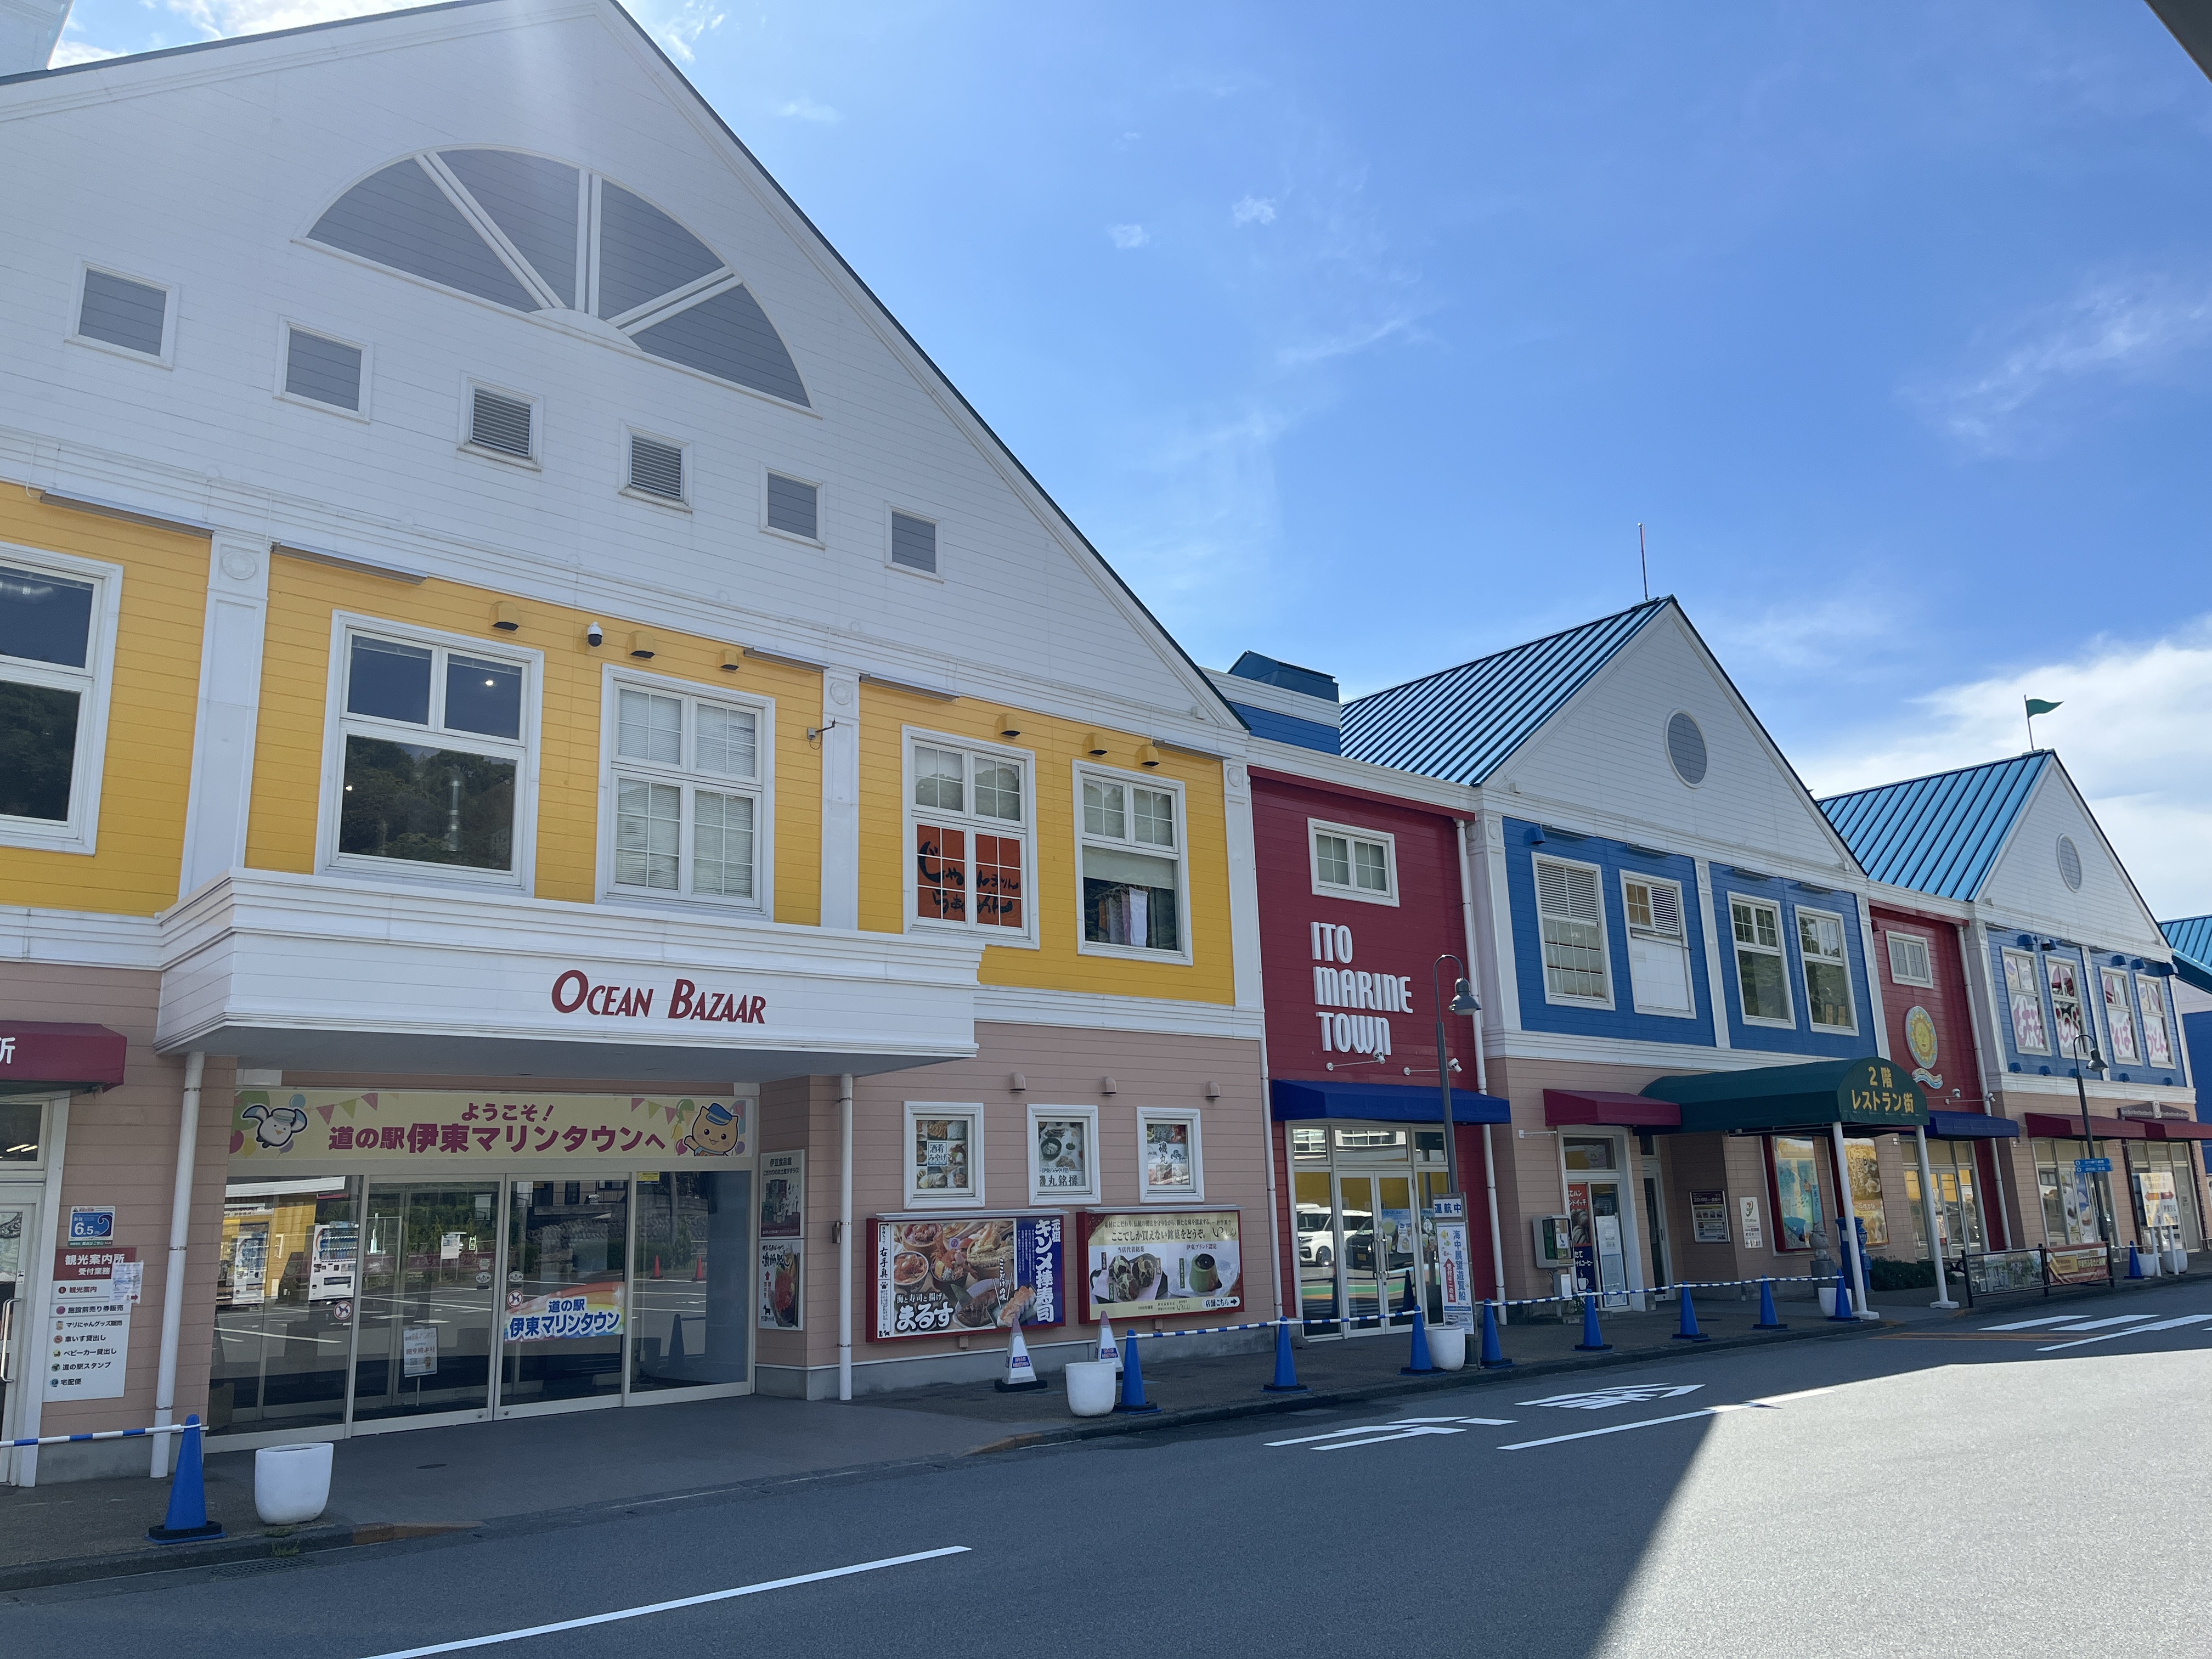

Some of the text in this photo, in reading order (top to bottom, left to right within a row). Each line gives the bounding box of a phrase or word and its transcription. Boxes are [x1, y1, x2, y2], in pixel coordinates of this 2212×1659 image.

[1310, 922, 1353, 964] ITO
[1313, 966, 1413, 1014] MARINE
[1316, 1012, 1392, 1056] TOWN
[1868, 1066, 1893, 1088] 2階
[1851, 1089, 1914, 1114] レストラン街
[328, 1123, 666, 1154] 道の駅伊東マリンタウンへ
[1434, 1203, 1462, 1214] 運航中
[74, 1221, 94, 1235] 6.5
[65, 1254, 126, 1266] 観光案内所
[1453, 1229, 1466, 1301] 海中展望遊覧船
[78, 1267, 110, 1276] 受付業務
[1035, 1218, 1054, 1323] キンメ棒寿司
[67, 1305, 124, 1314] 施設前売り券販売
[549, 1298, 585, 1313] 道の駅
[509, 1311, 620, 1338] 伊東マリンタウン
[896, 1301, 954, 1331] まるす
[64, 1334, 106, 1343] 車いす貸出し
[63, 1347, 117, 1357] ベビーカー貸出し
[62, 1362, 112, 1372] 道の駅スタンプ
[60, 1378, 82, 1386] 宅配便
